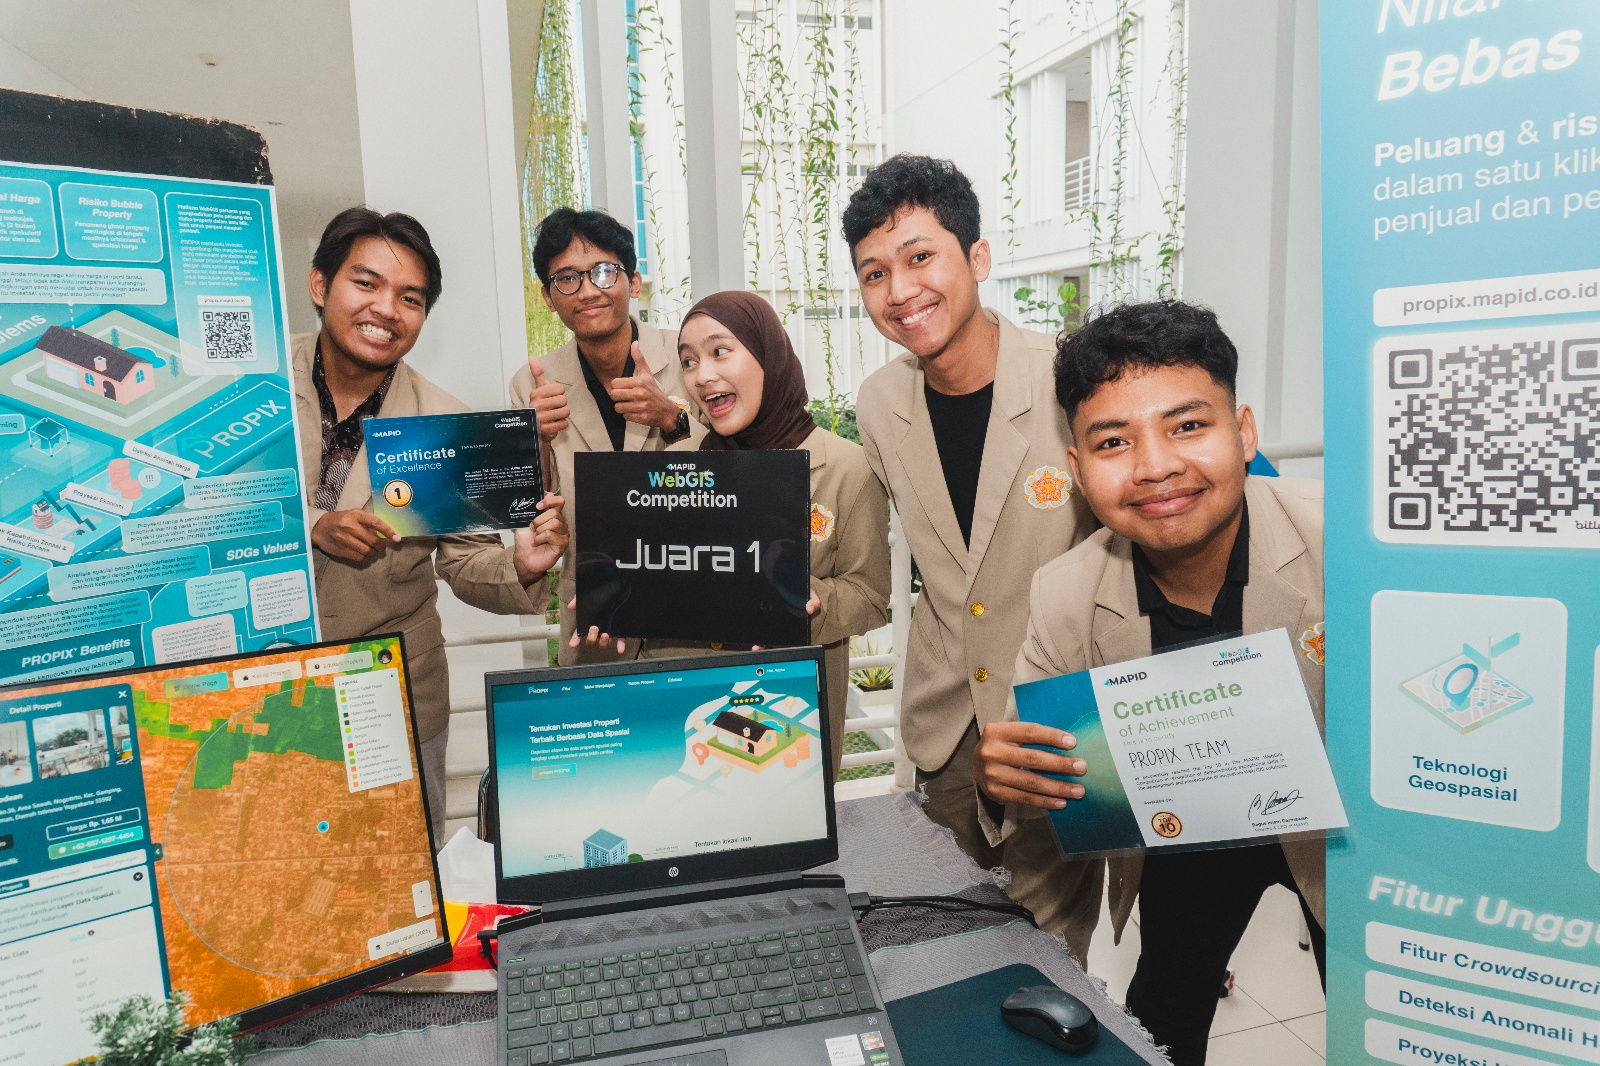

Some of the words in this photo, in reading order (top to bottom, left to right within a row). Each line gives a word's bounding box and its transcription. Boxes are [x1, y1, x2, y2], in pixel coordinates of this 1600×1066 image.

[1378, 30, 1583, 101] Bebas
[1374, 129, 1505, 167] Peluang
[1517, 120, 1540, 145] &
[1373, 172, 1463, 201] dalam
[1474, 160, 1541, 187] satu
[10, 194, 40, 205] Harga
[78, 197, 108, 207] Risiko
[110, 199, 143, 210] Bubble
[92, 208, 132, 220] Property
[1374, 199, 1480, 240] penjual
[1491, 196, 1550, 221] dan
[1403, 282, 1598, 316] propix.mapid.co.id
[0, 314, 47, 345] lems
[193, 399, 287, 459] PROPIX
[375, 447, 456, 465] Certificate
[376, 465, 387, 475] of
[389, 461, 442, 474] Excellence
[648, 471, 715, 488] WebGIS
[73, 489, 99, 502] Proyeksi
[394, 487, 401, 500] 1
[626, 489, 738, 511] Competition
[1575, 520, 1600, 533] bitl
[226, 547, 260, 561] SDGs
[263, 541, 299, 555] Values
[615, 538, 735, 573] Juara
[746, 540, 760, 573] 1
[80, 639, 131, 656] Benefits
[1212, 651, 1262, 667] Competition
[202, 680, 218, 688] Page
[1109, 671, 1147, 686] MAPID
[9, 705, 31, 714] Detail
[32, 700, 62, 711] Properti
[1113, 682, 1243, 720] Certificate
[529, 724, 560, 733] Temukan
[562, 720, 592, 730] Investasi
[593, 717, 620, 727] Properti
[1119, 724, 1133, 738] of
[1138, 706, 1235, 734] Achievement
[529, 735, 555, 744] Terbaik
[556, 732, 586, 742] Berbasis
[587, 731, 604, 739] Data
[605, 728, 630, 737] Spasial
[1128, 747, 1182, 769] PROPIX
[1184, 739, 1231, 760] TEAM
[1412, 755, 1508, 782] Teknologi
[1408, 775, 1518, 802] Geospasial
[63, 800, 94, 810] Yogyakarta
[1159, 822, 1176, 834] 10
[57, 902, 74, 910] Layer
[76, 897, 91, 905] Data
[92, 891, 114, 901] Spasial
[1368, 875, 1464, 917] Fitur
[1475, 895, 1600, 948] Ungg
[1400, 940, 1447, 963] Fitur
[16, 968, 44, 981] Properti
[1399, 990, 1474, 1020] Deteksi
[1481, 1010, 1573, 1042] Anomali
